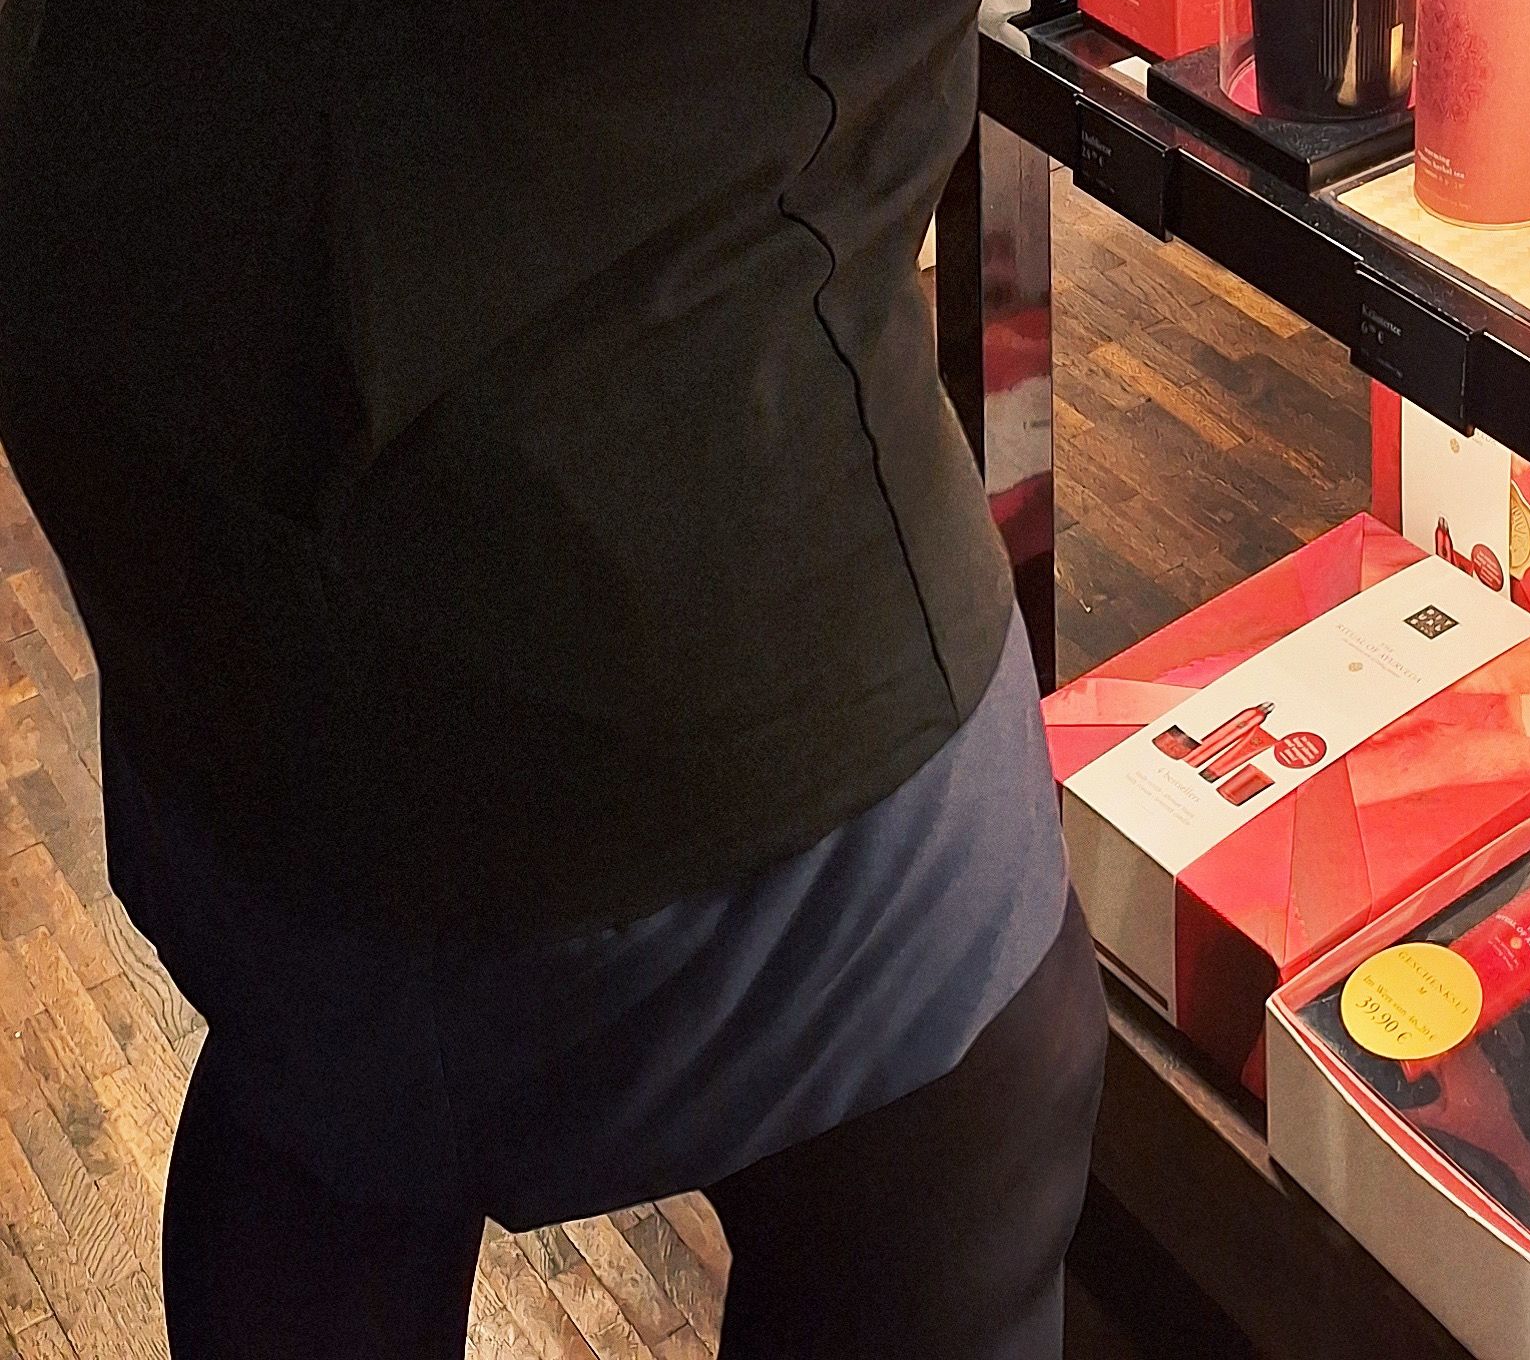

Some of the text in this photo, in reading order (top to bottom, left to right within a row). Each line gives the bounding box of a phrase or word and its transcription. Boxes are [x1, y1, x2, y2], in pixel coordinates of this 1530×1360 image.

[1516, 926, 1528, 939] OF
[1363, 974, 1375, 988] Im
[1376, 983, 1393, 1005] Wert
[1397, 950, 1471, 1016] GESCHENKSET
[1355, 995, 1414, 1045] 39,90 €
